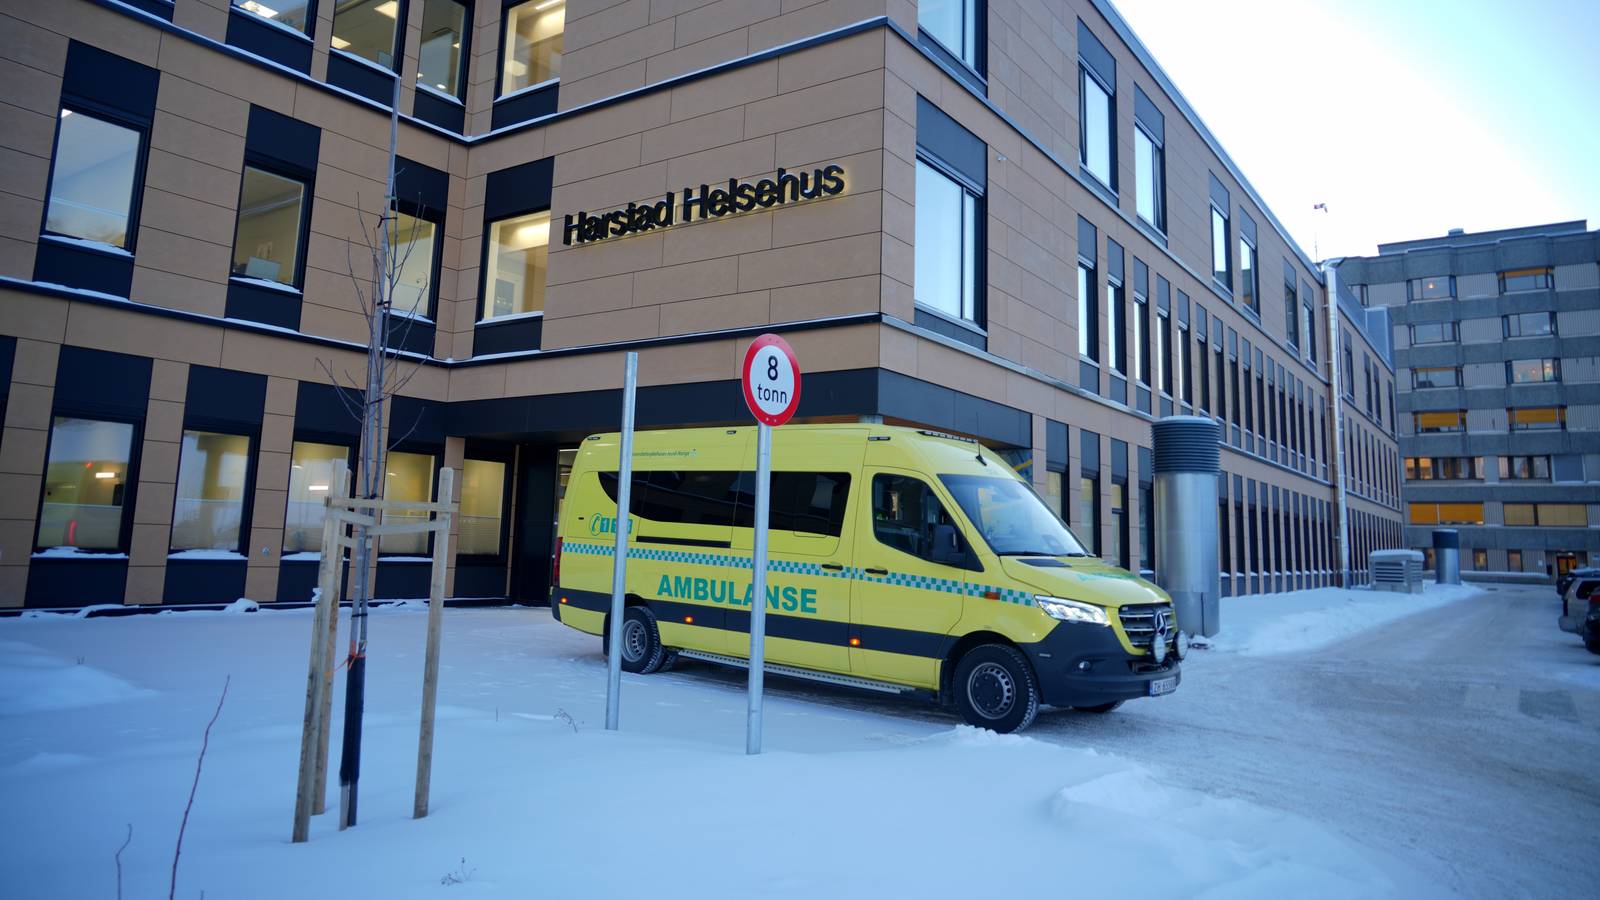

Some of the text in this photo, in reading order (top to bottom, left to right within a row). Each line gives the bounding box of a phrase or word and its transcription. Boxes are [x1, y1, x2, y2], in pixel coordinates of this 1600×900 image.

[563, 164, 845, 246] Harstad Helsehus
[767, 355, 779, 381] 8
[757, 384, 787, 404] tonn
